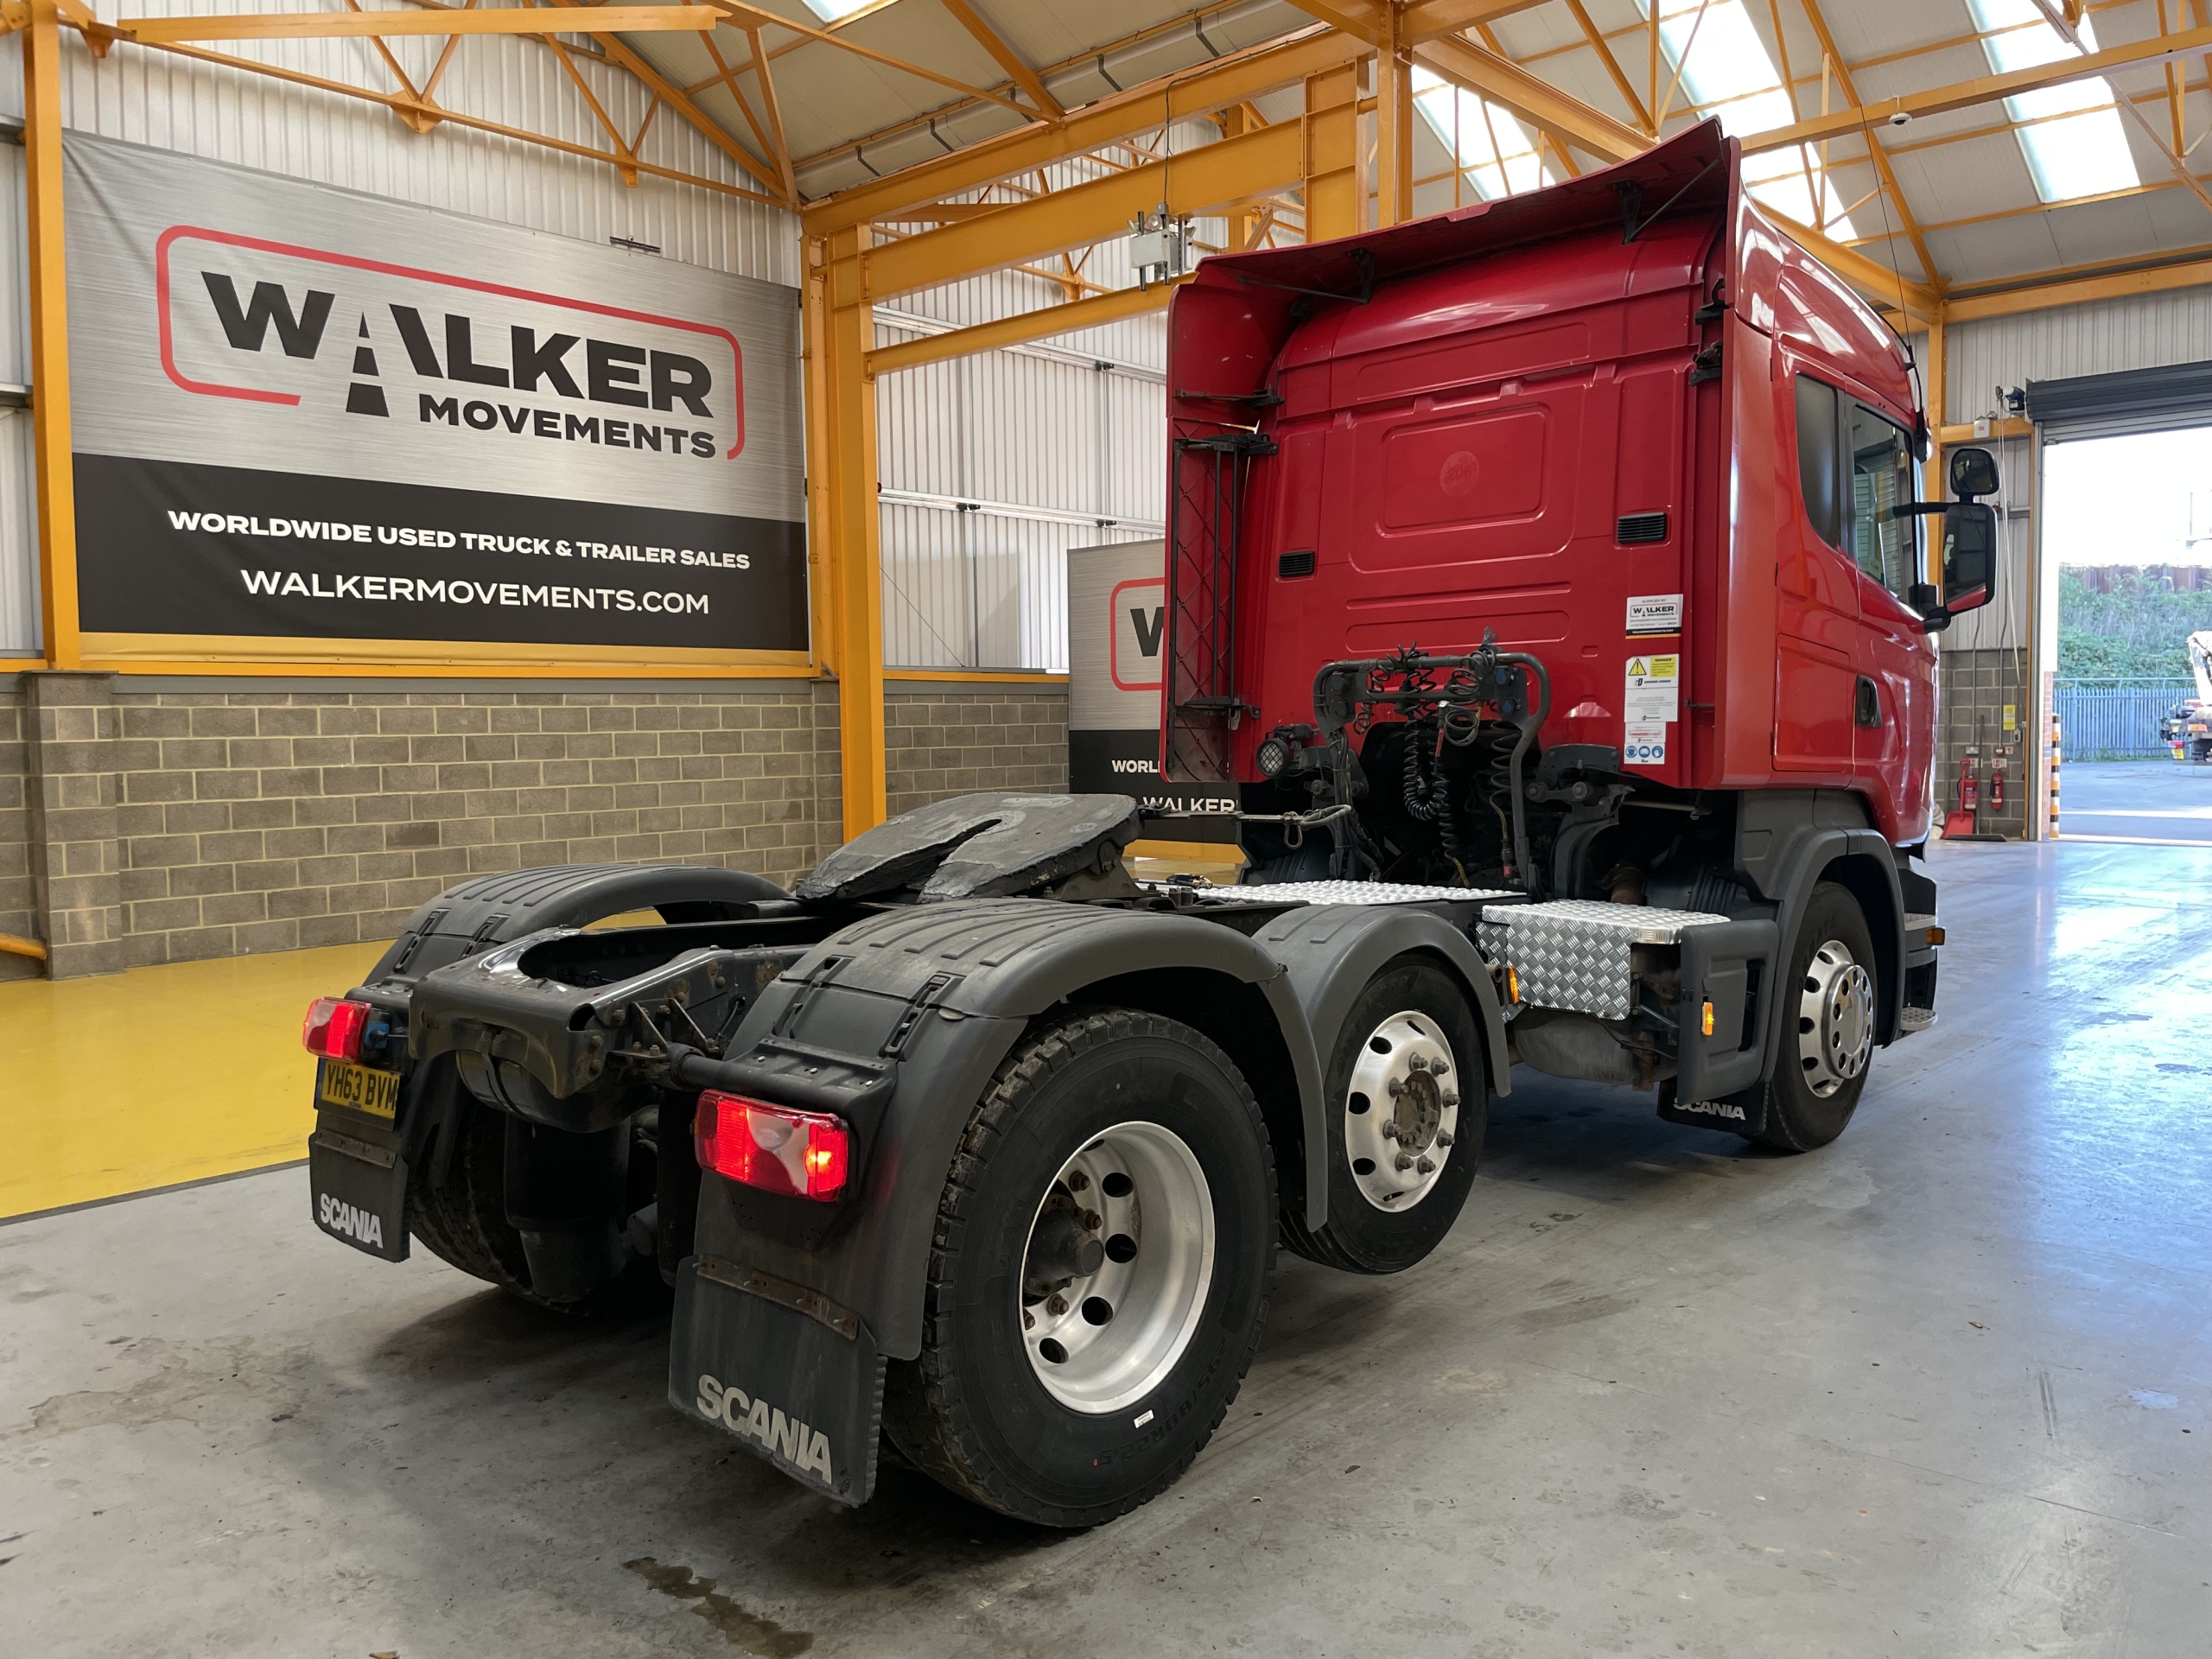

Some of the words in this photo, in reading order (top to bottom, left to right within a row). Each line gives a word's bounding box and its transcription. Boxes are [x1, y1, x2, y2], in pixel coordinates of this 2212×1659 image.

[201, 271, 714, 417] WALKER
[419, 393, 716, 459] MOVEMENTS
[168, 511, 372, 543] WORLDWIDE
[378, 525, 456, 548] USED
[460, 532, 551, 555] TRUCK
[555, 539, 573, 557] &
[575, 541, 677, 564] TRAILER
[680, 550, 750, 569] SALES
[240, 569, 709, 613] WALKERMOVEMENTS.COM
[1633, 606, 1675, 617] WALKER
[1111, 760, 1160, 773] WORL
[1142, 797, 1238, 812] WALKER
[327, 1064, 363, 1102] YH63
[365, 1073, 398, 1111] BVM
[320, 1192, 384, 1249] SCANIA
[696, 1374, 832, 1484] SCANIA
